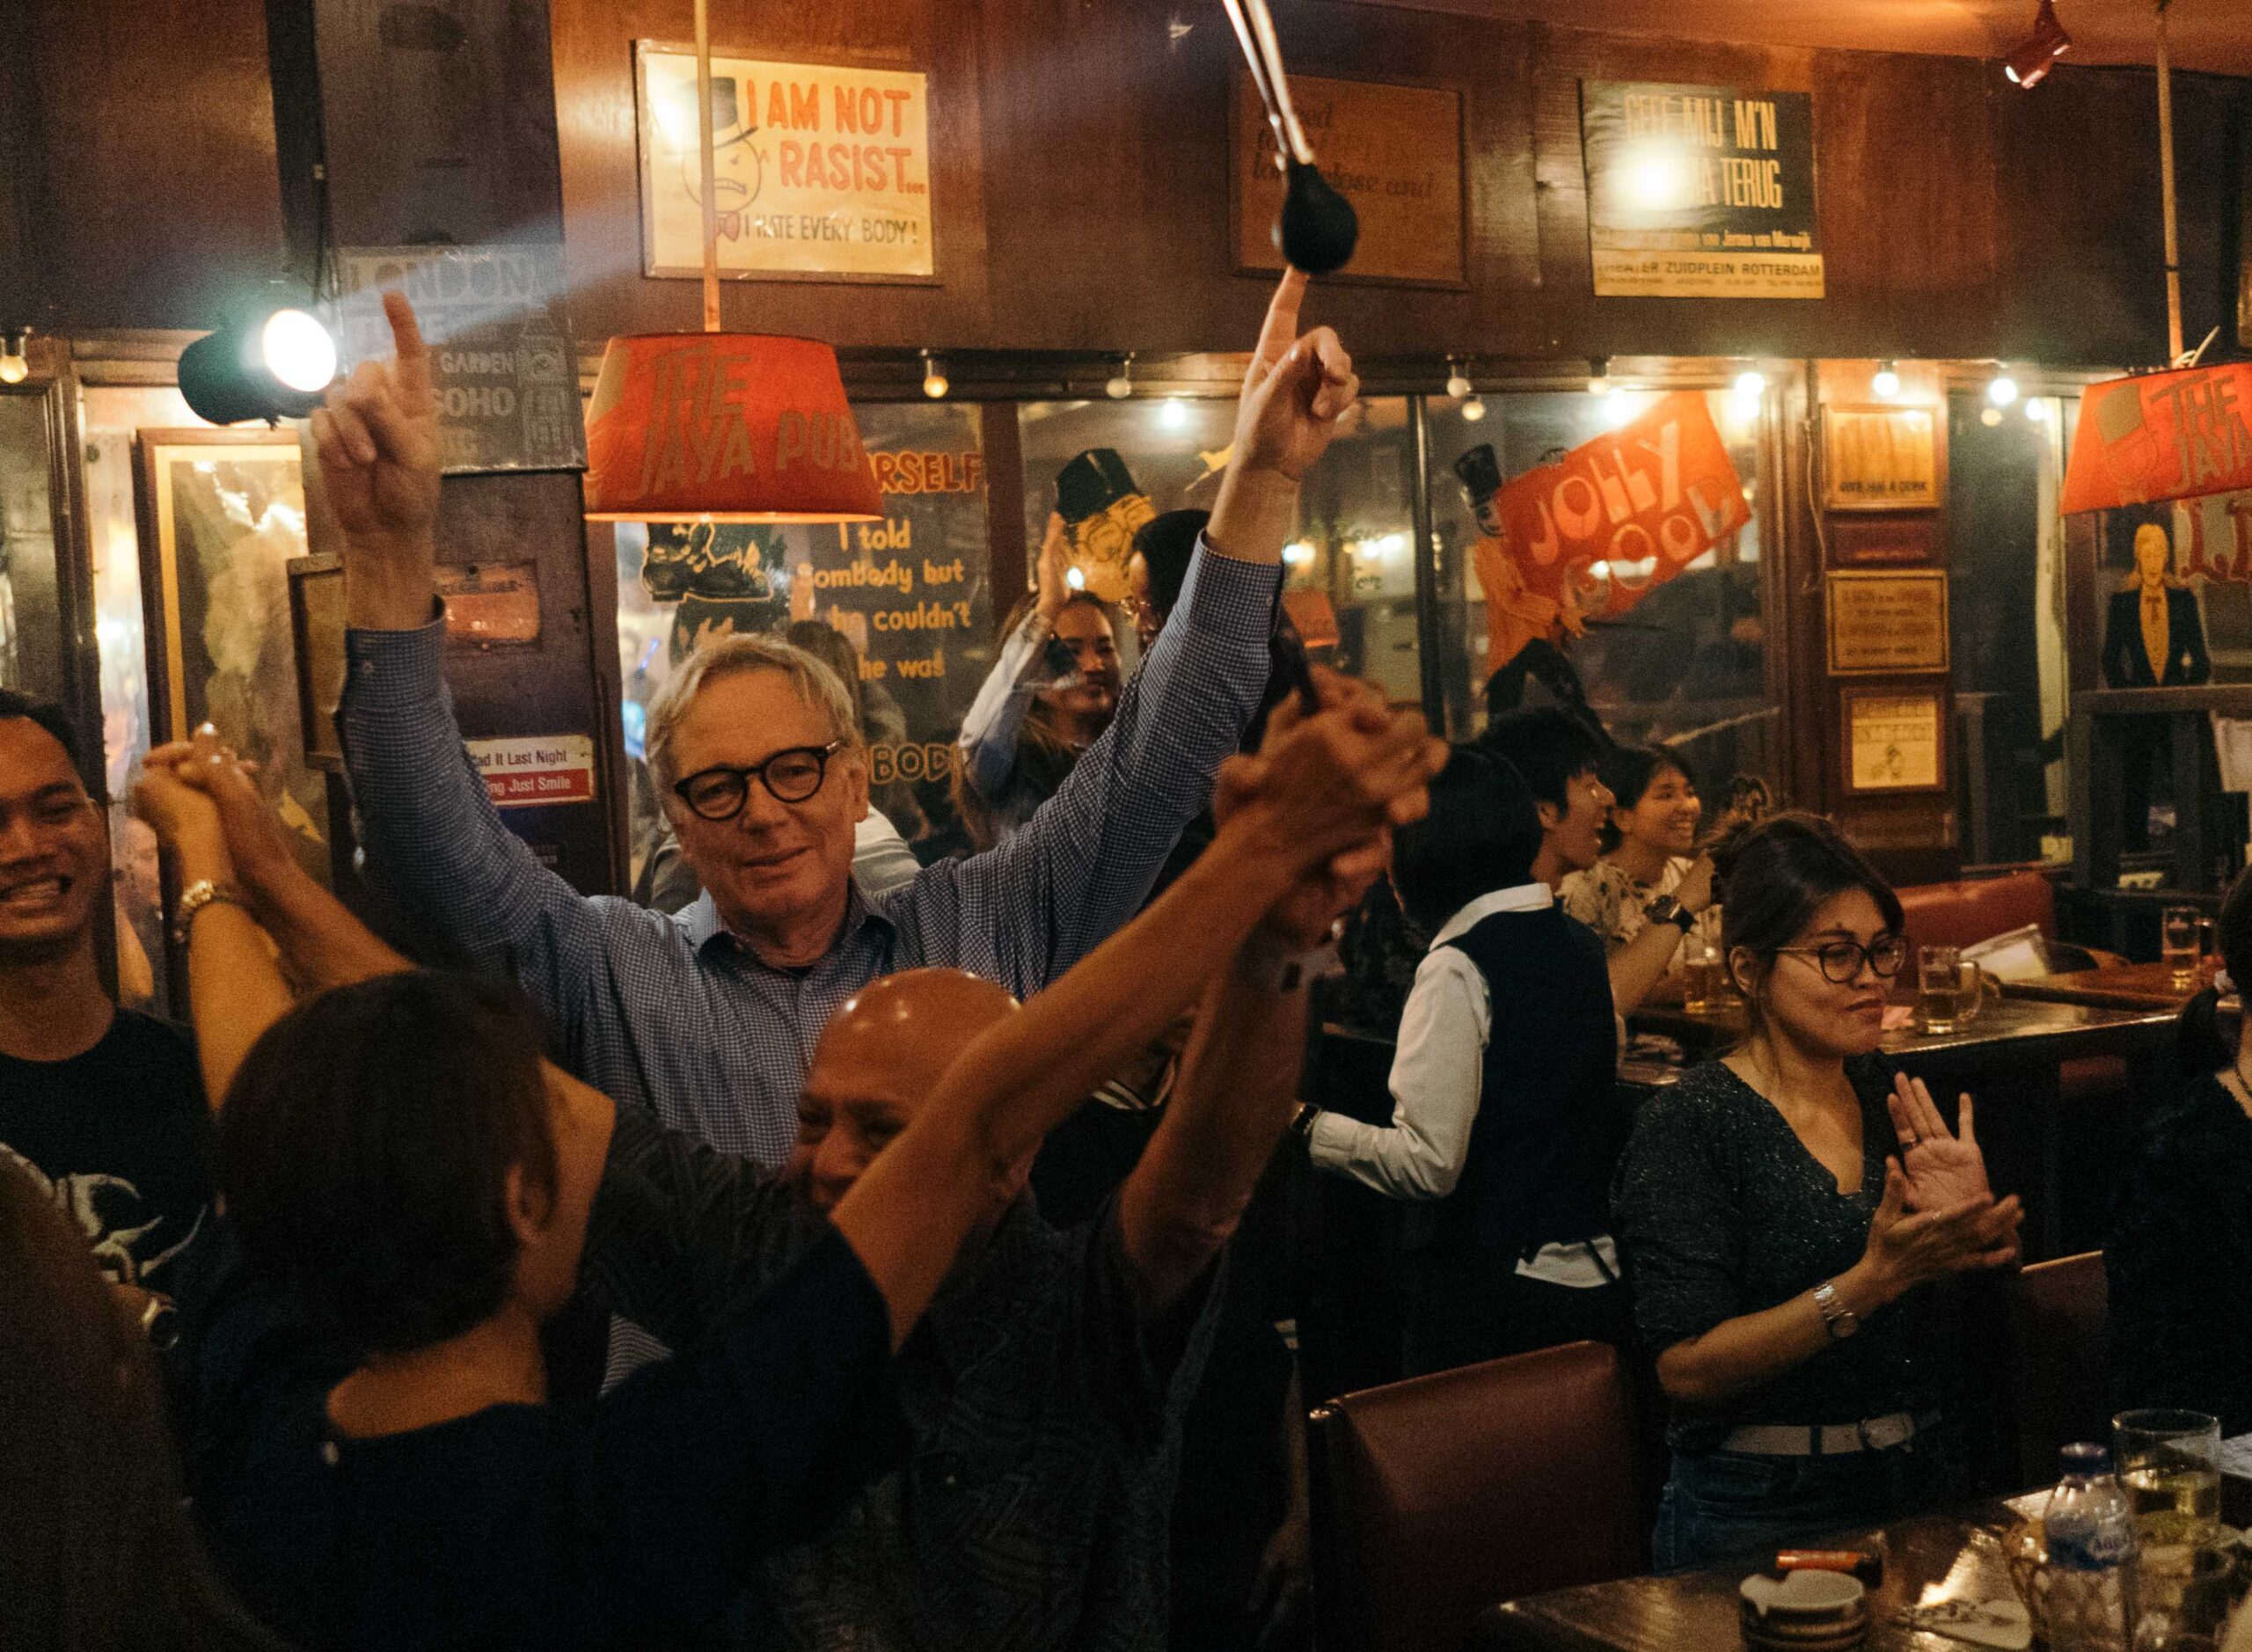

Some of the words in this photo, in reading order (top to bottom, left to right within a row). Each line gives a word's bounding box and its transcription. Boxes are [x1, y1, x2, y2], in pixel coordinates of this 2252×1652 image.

[747, 79, 757, 128] I
[767, 81, 820, 131] AM
[835, 85, 911, 137] NOT
[1720, 157, 1782, 208] TERUG
[757, 214, 793, 240] HATE
[801, 216, 854, 242] EVERY
[1664, 261, 1736, 275] ZUIDPLEIN
[1741, 263, 1821, 277] ROTTERDAM
[441, 352, 517, 375] GARDEN
[649, 343, 751, 422] THE
[2149, 370, 2238, 438] THE
[619, 411, 755, 501] JAVA
[775, 409, 861, 471] PUB
[866, 450, 983, 494] RSELF
[1530, 419, 1680, 566] JOLLY
[859, 518, 912, 551] told
[812, 559, 913, 596] ombody
[923, 558, 966, 587] but
[872, 600, 973, 632] couldn't
[508, 751, 532, 766] Last
[535, 749, 568, 766] Night
[508, 778, 535, 793] Just
[537, 775, 572, 792] Smile
